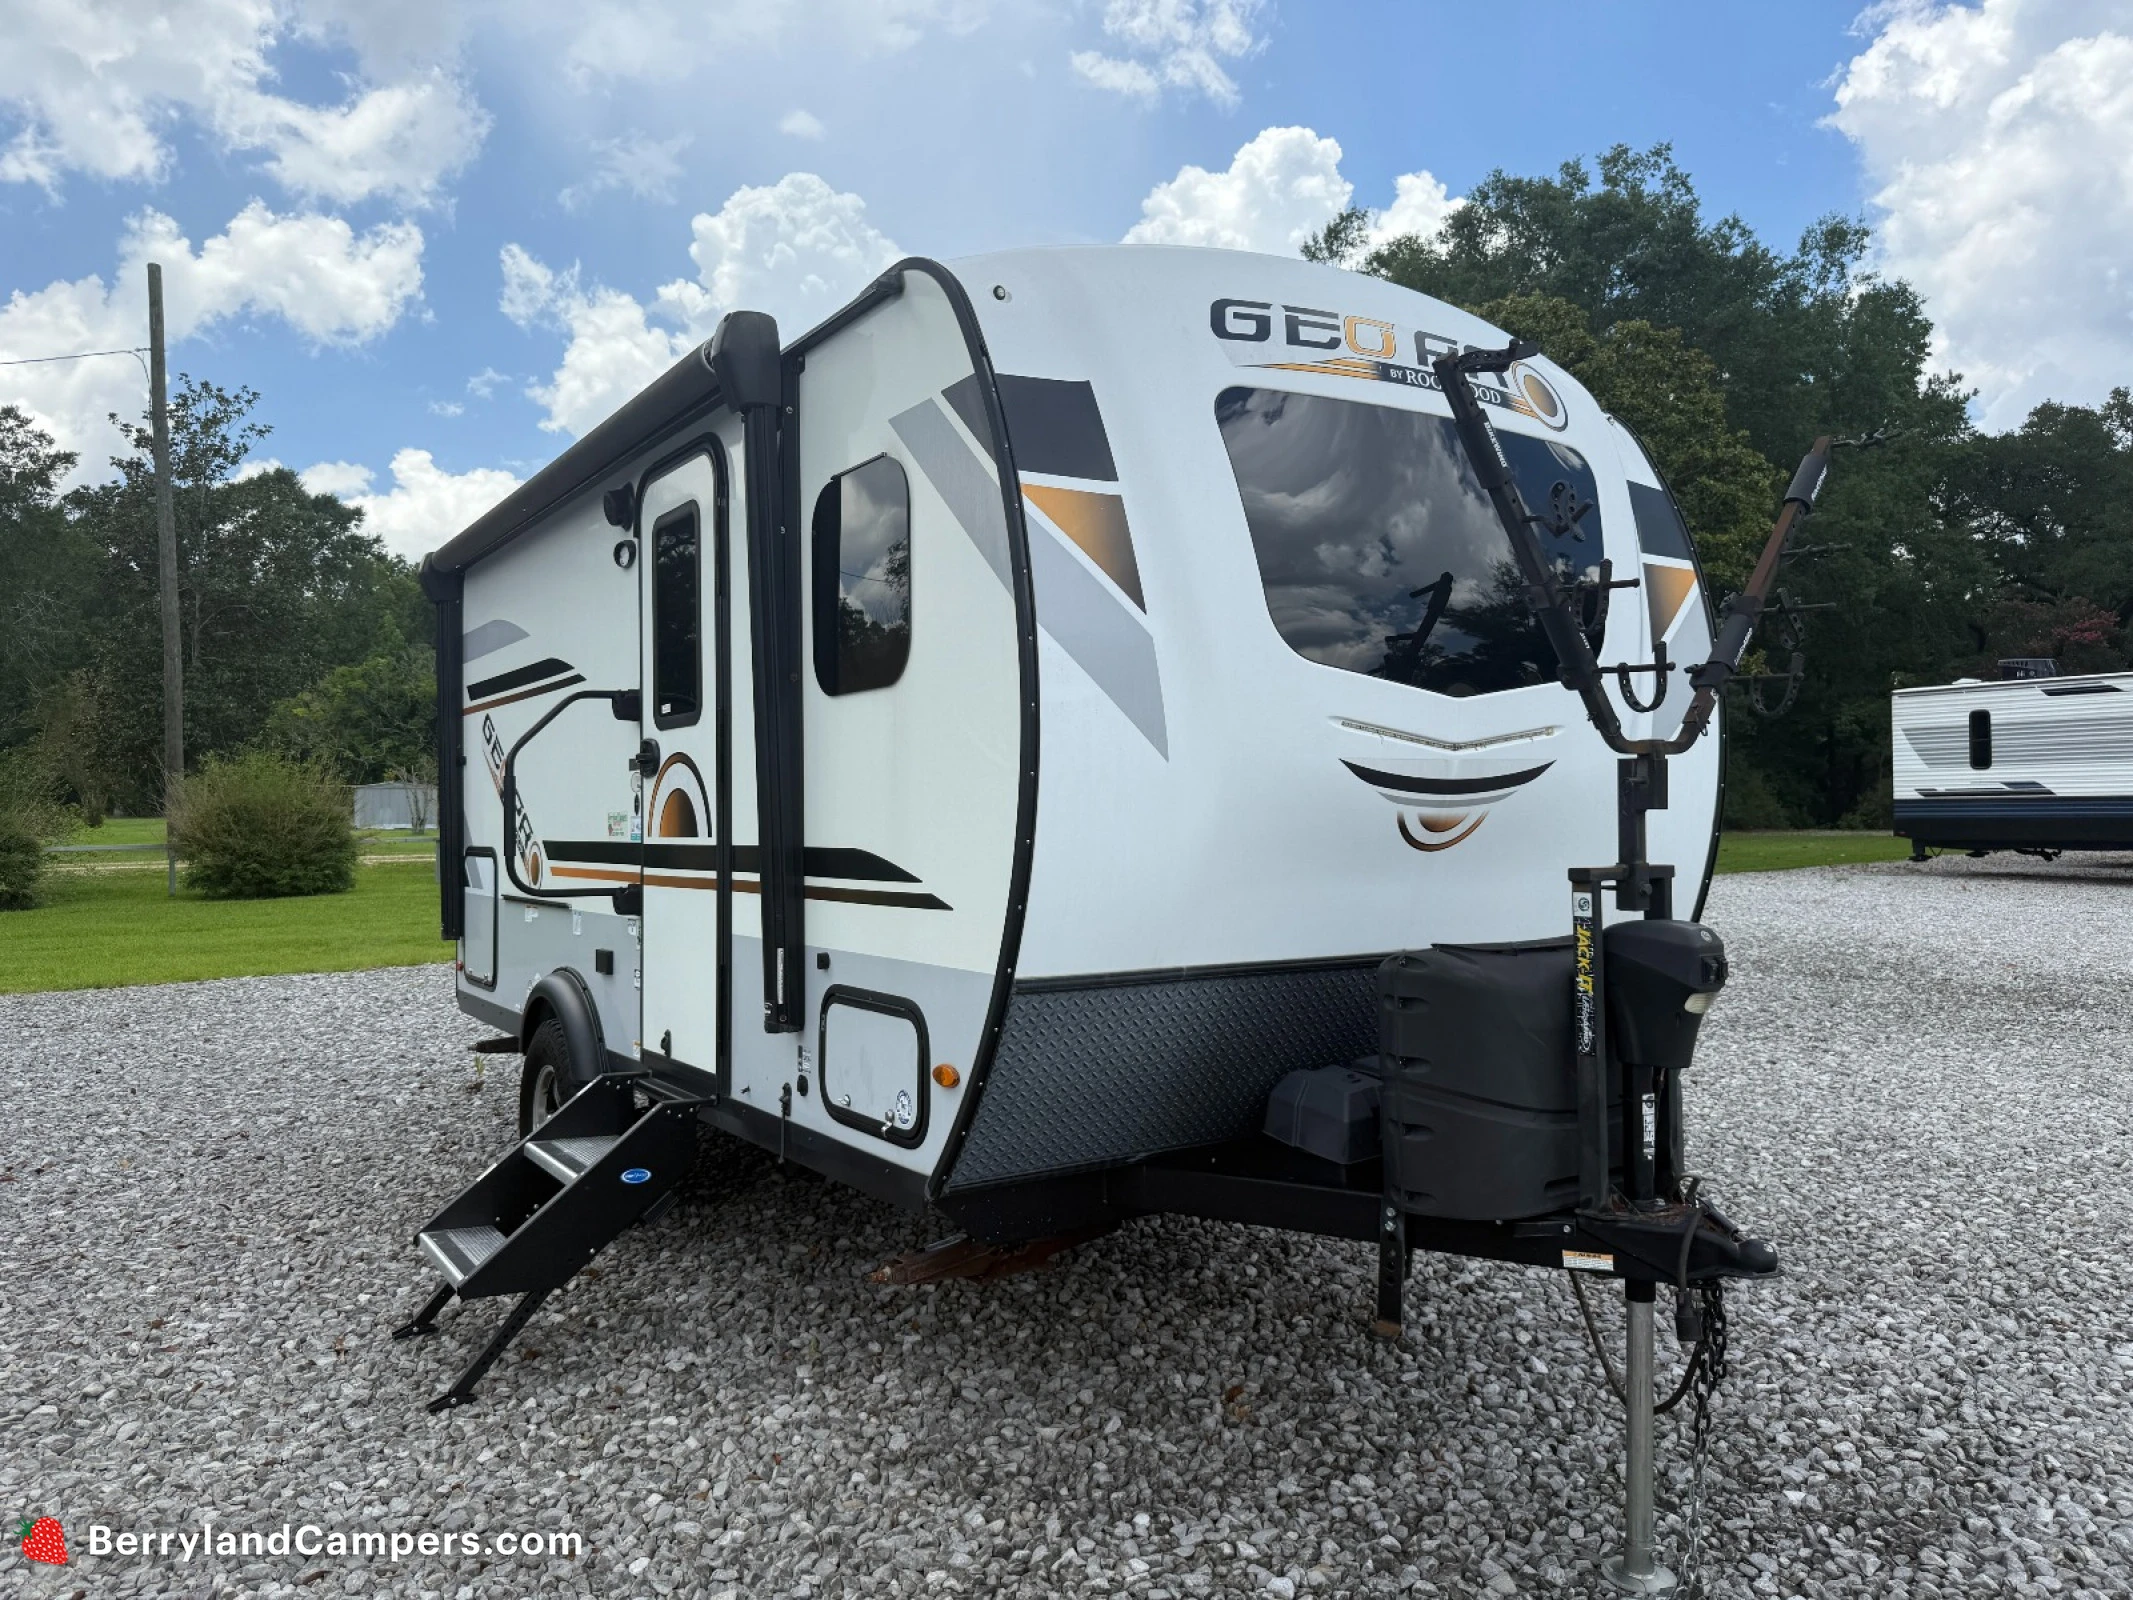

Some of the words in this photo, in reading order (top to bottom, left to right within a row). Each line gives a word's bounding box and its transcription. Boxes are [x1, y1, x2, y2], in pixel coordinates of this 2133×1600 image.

[1210, 298, 1396, 360] GEO
[1389, 367, 1404, 380] BY
[1406, 369, 1501, 404] ROCOOD
